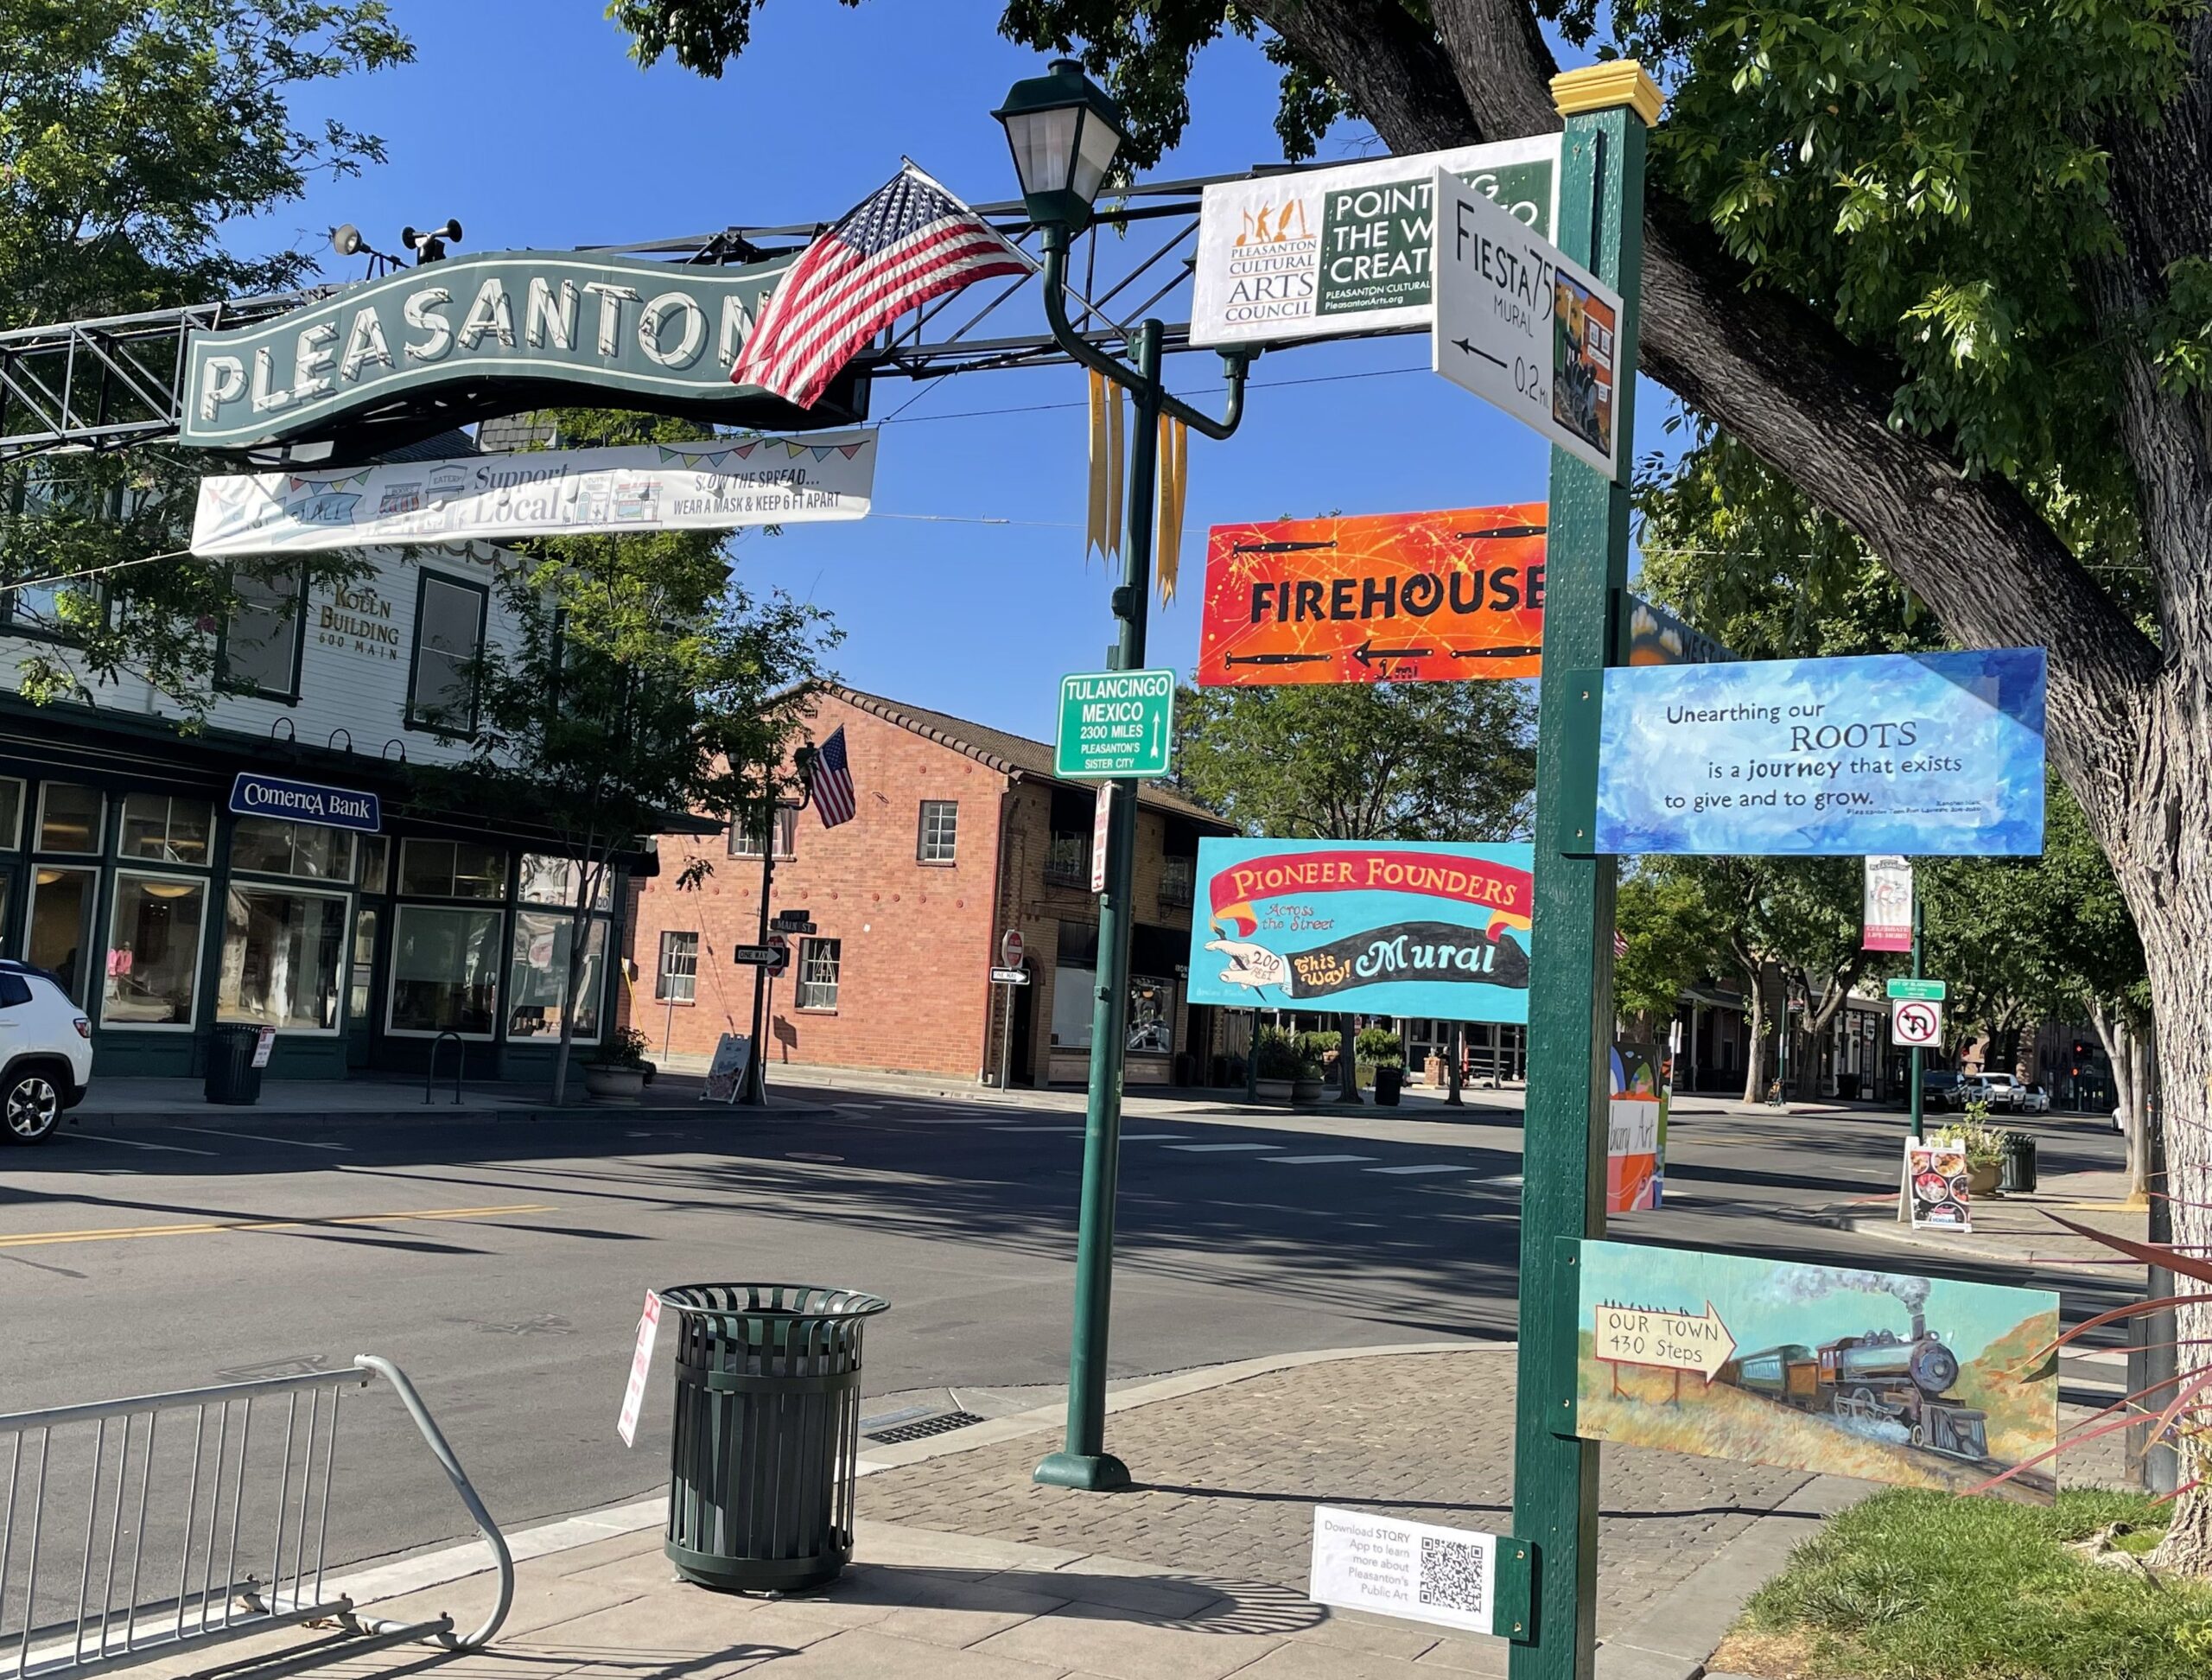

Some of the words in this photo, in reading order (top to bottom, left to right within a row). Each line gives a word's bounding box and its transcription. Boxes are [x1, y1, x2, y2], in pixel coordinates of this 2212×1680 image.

[1333, 221, 1389, 251] THE
[1231, 239, 1317, 258] PLEASANTON
[1457, 199, 1532, 307] FIESTA
[1230, 254, 1315, 275] CULTURAL
[1229, 271, 1314, 303] ARTS
[1325, 286, 1384, 300] PLEASANTON
[1386, 281, 1431, 295] CULTURAL
[1225, 301, 1312, 322] COUNCIL
[1325, 296, 1403, 310] PleasantonArts.org
[1493, 295, 1534, 339] MURAL
[200, 276, 771, 422] PLEASANTON
[1515, 355, 1539, 402] 0.2
[474, 463, 571, 494] Support
[733, 472, 756, 489] THE
[471, 486, 562, 524] Local
[673, 498, 702, 515] WEAR
[703, 498, 711, 514] A
[713, 496, 744, 513] MASK
[745, 496, 753, 512] &
[755, 495, 781, 512] KEEP
[783, 495, 791, 510] 6
[792, 493, 804, 510] FT
[805, 491, 842, 509] APART
[1249, 563, 1546, 624] FIREHOUSE
[320, 604, 399, 646] BUILDING
[319, 633, 345, 648] 600
[354, 640, 397, 660] MAIN
[1395, 659, 1418, 679] mi
[1066, 676, 1168, 701] TULANCINGO
[1082, 702, 1144, 723] MEXICO
[1666, 702, 1781, 725] Unearthing
[1788, 702, 1826, 718] our
[1080, 725, 1108, 740] 2300
[1111, 724, 1143, 738] MILES
[1789, 721, 1918, 753] ROOTS
[1081, 741, 1141, 754] PLEASANTON'S
[1084, 759, 1113, 770] SISTER
[1116, 758, 1135, 769] CITY
[1707, 760, 1723, 780] is
[1731, 766, 1740, 778] a
[1745, 759, 1843, 782] journey
[1849, 758, 1894, 774] that
[1901, 754, 1962, 773] exists
[328, 795, 371, 819] Bank
[1664, 793, 1686, 809] to
[1694, 792, 1732, 813] give
[1739, 790, 1777, 807] and
[1783, 790, 1807, 807] to
[1814, 790, 1874, 811] grow.
[1230, 862, 1357, 899] PIONEER
[1366, 857, 1517, 906] FOUNDERS
[1264, 902, 1314, 916] Across
[1262, 918, 1284, 930] the
[1290, 916, 1335, 932] Street
[739, 950, 753, 958] ONE
[754, 951, 768, 959] WAY
[1253, 950, 1280, 971] 200
[1294, 953, 1336, 974] This
[1355, 934, 1497, 978] Mural
[1249, 967, 1276, 982] FEET
[1609, 1312, 1649, 1333] OUR
[1662, 1318, 1719, 1341] TOWN
[1610, 1334, 1645, 1354] 430
[1656, 1339, 1702, 1365] Steps
[1325, 1520, 1374, 1538] Download
[1376, 1528, 1411, 1543] STQRY
[1349, 1538, 1370, 1553] App
[1373, 1543, 1383, 1554] to
[1385, 1545, 1410, 1558] learn
[1352, 1556, 1378, 1567] more
[1380, 1559, 1409, 1573] about
[1348, 1566, 1409, 1588] Pleasanton's
[1361, 1582, 1391, 1599] Public
[1393, 1588, 1408, 1601] Art
